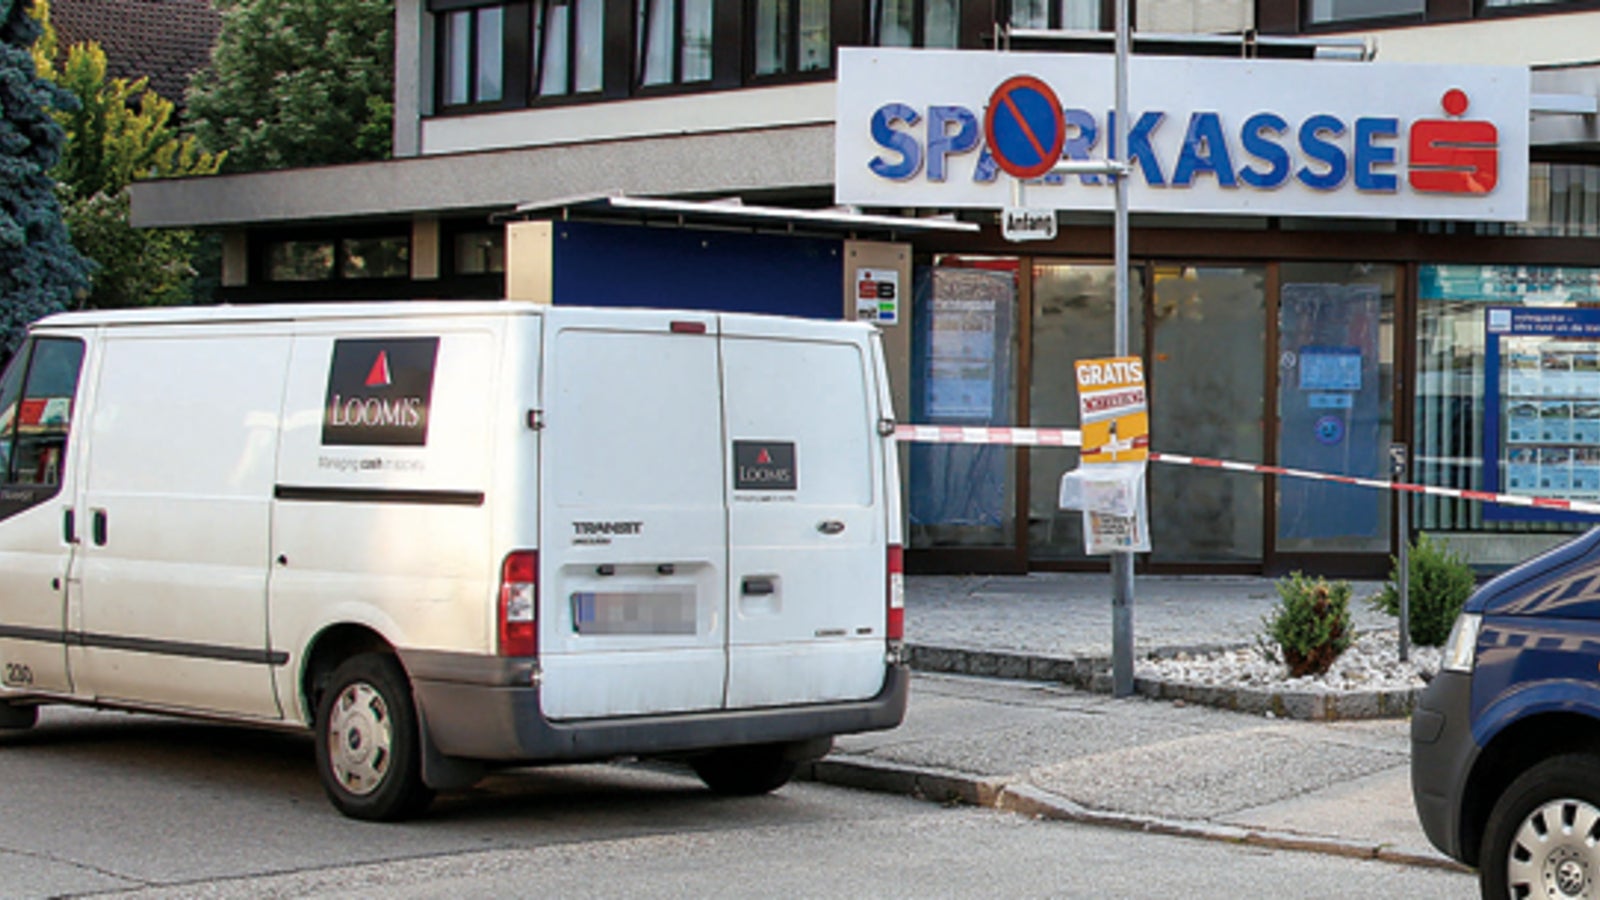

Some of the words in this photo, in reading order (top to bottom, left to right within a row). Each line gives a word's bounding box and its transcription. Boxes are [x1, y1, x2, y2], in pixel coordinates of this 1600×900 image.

[867, 102, 1399, 193] SPRKASSE
[1006, 212, 1052, 236] Anfang
[1076, 361, 1144, 386] GRATIS
[332, 394, 421, 428] LOOMIS
[572, 521, 644, 534] TRANSIT
